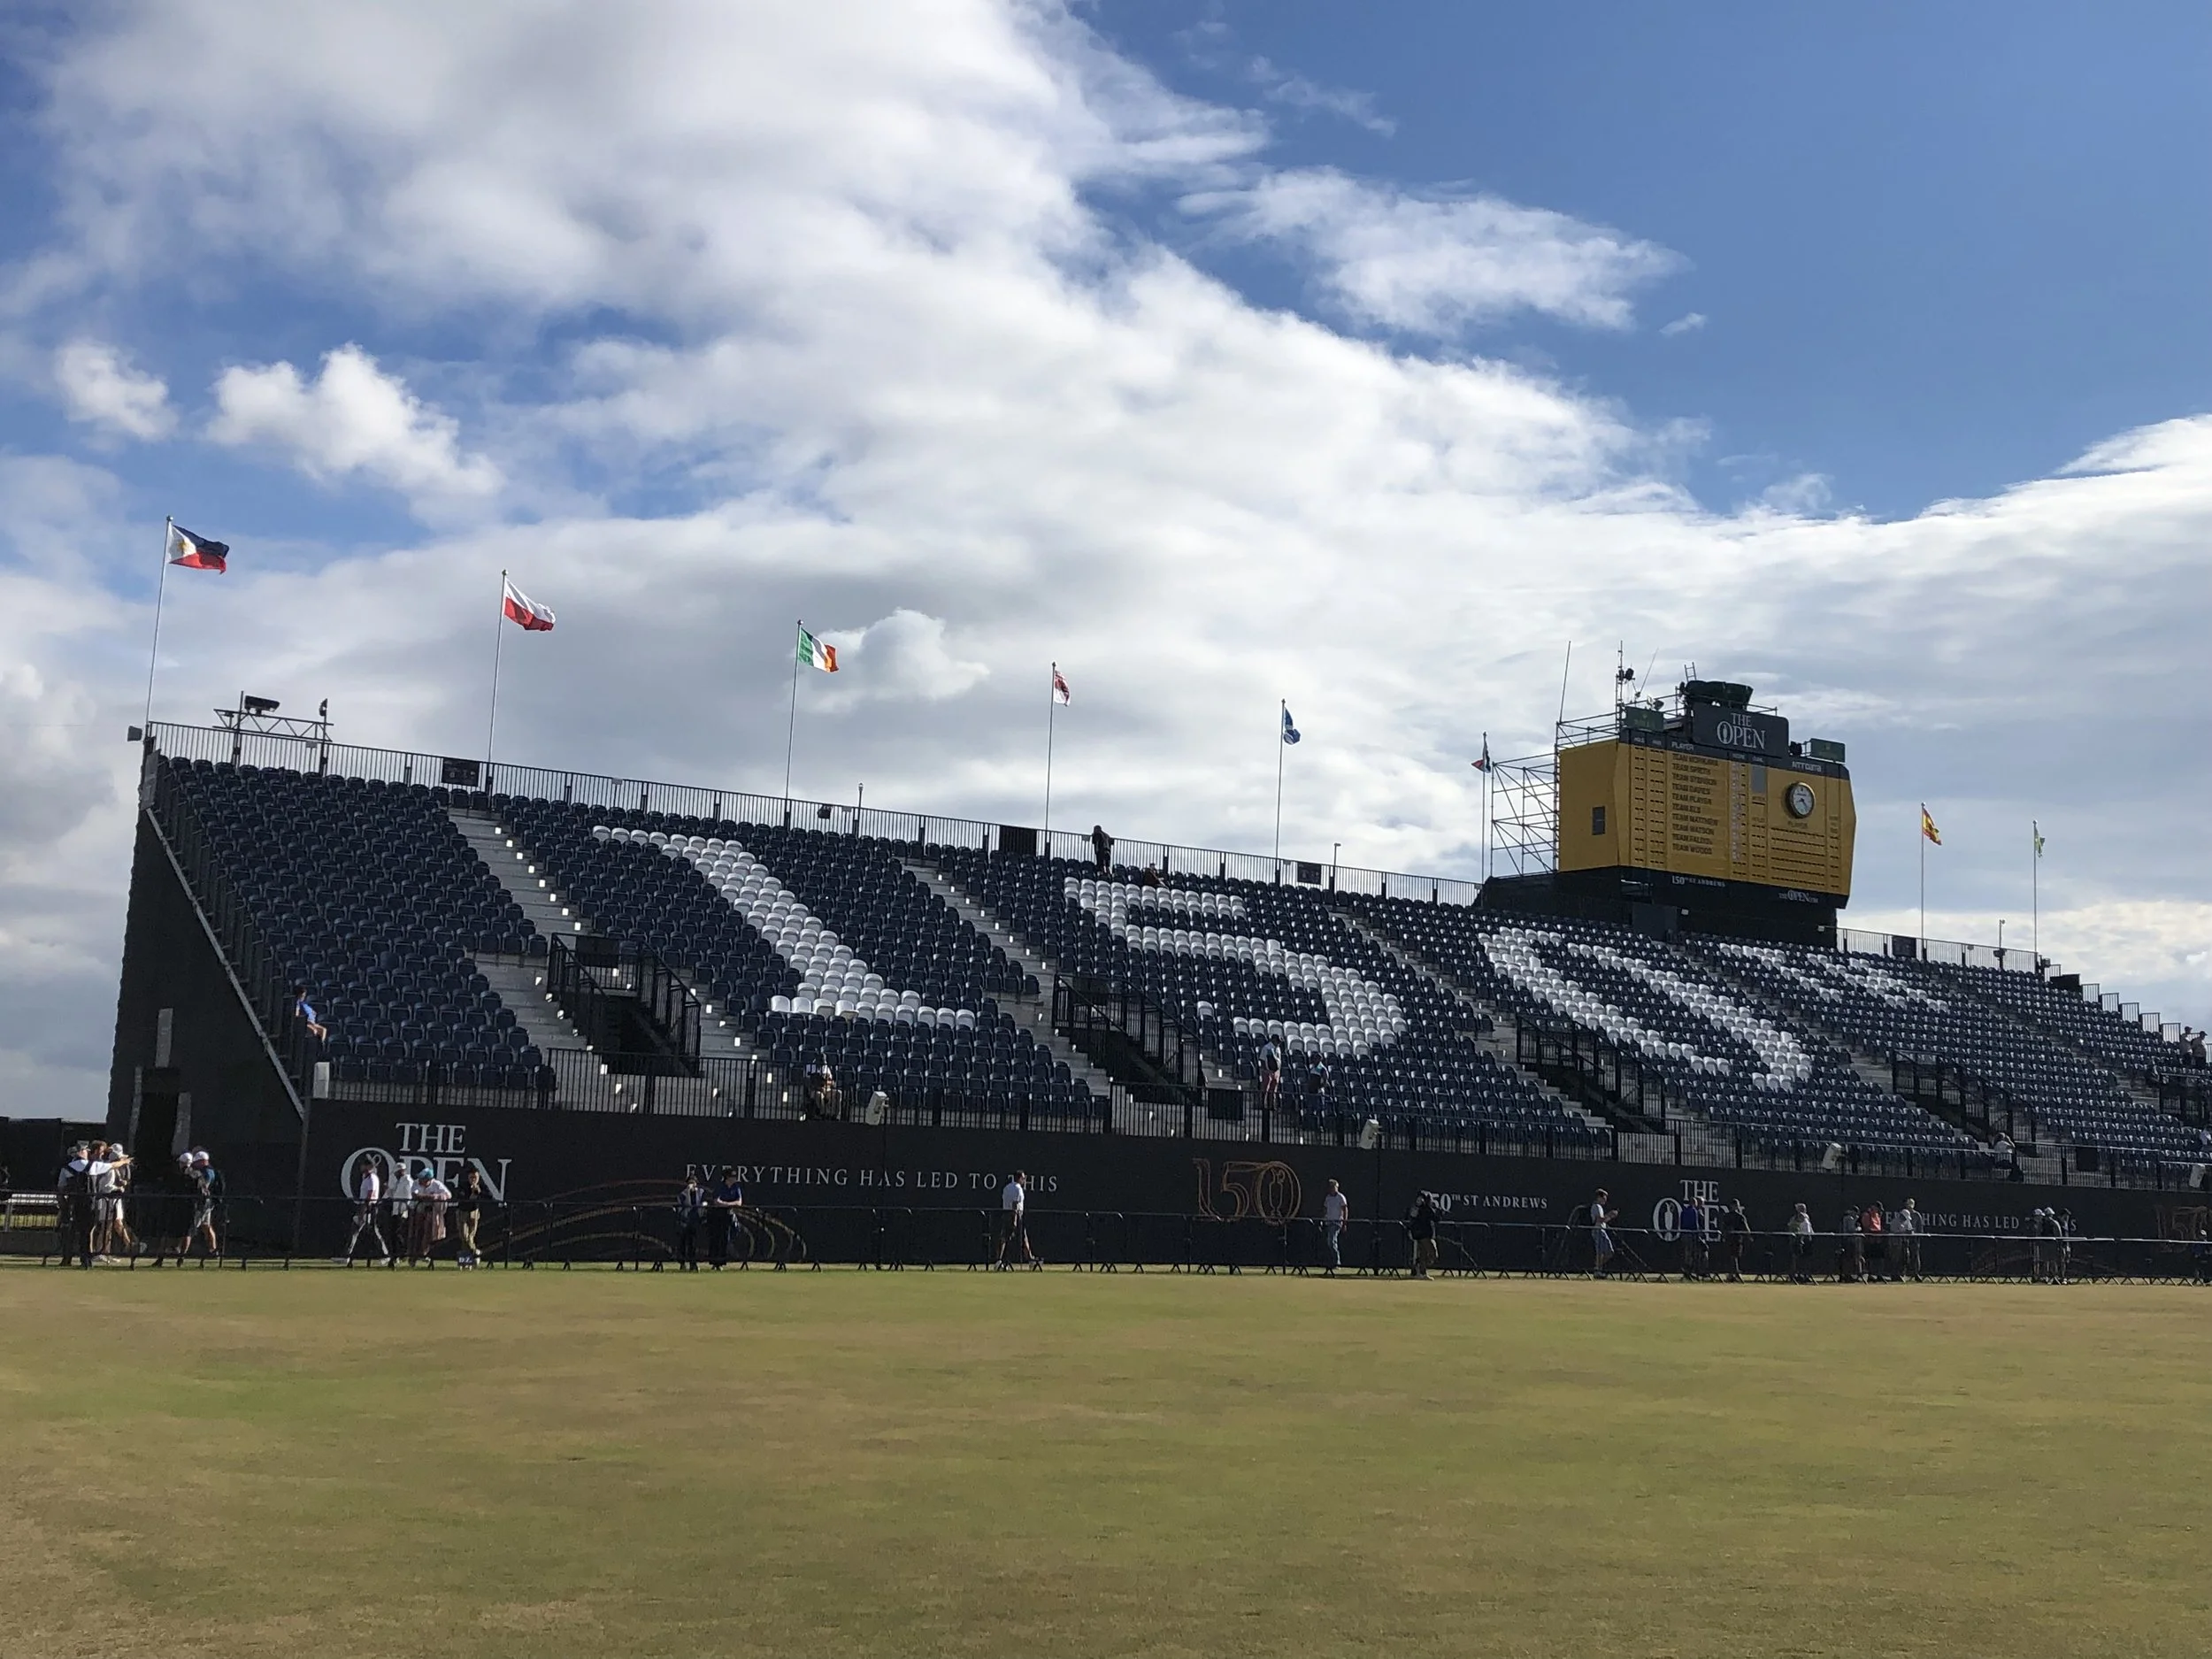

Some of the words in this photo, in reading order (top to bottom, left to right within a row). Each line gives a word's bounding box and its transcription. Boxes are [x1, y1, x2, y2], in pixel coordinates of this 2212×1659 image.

[1731, 712, 1752, 727] THE
[1717, 720, 1766, 750] OPEN
[396, 1123, 466, 1154] THE
[859, 1169, 905, 1187] HAS
[917, 1171, 958, 1189] LED
[969, 1172, 997, 1190] TO
[1679, 1179, 1719, 1202] THE
[1193, 1157, 1302, 1226] 150
[1463, 1194, 1479, 1206] ST
[1483, 1195, 1548, 1210] ANDREWS
[1962, 1214, 1989, 1228] HAS
[1995, 1216, 2019, 1229] LED
